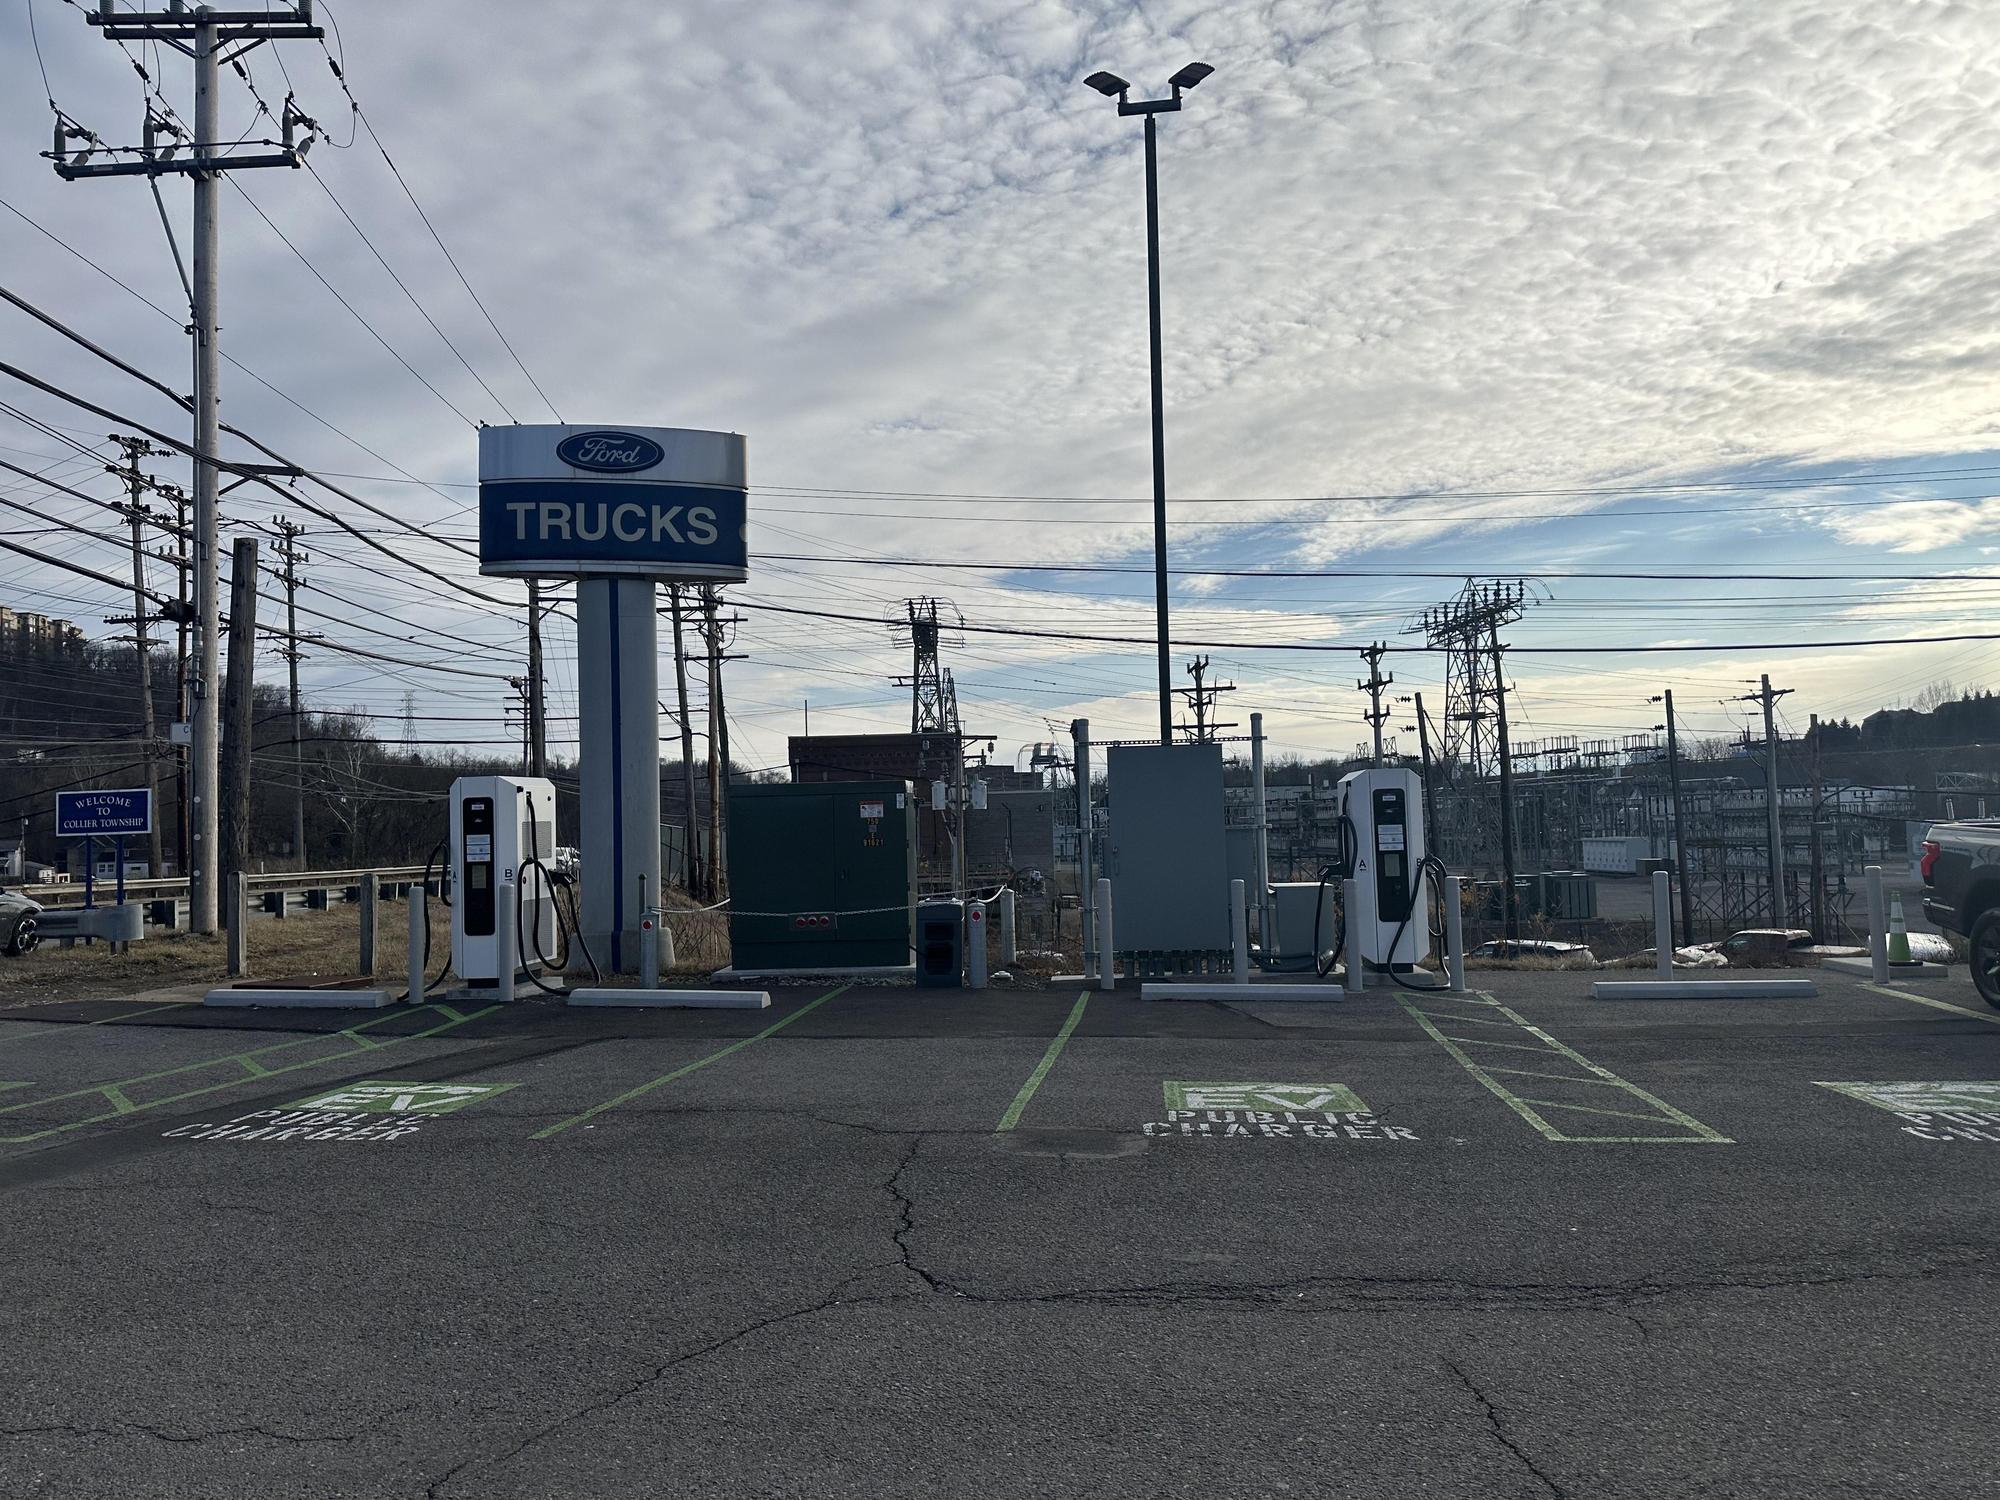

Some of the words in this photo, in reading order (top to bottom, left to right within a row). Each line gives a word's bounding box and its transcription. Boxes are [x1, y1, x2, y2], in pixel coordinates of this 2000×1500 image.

[578, 437, 640, 463] Ford
[506, 502, 718, 545] TRUCKS
[75, 796, 132, 809] WELCOME
[96, 807, 111, 816] TO
[63, 819, 98, 829] COLLIER
[100, 817, 144, 828] TOWNSHIP
[1359, 859, 1367, 868] A
[452, 871, 457, 879] A
[504, 868, 513, 878] B
[1185, 1092, 1336, 1110] EV
[228, 1110, 435, 1126] PUBLIC
[1167, 1110, 1379, 1125] PUBLIC
[161, 1123, 421, 1141] CHARGER
[1142, 1121, 1420, 1141] CHARGER
